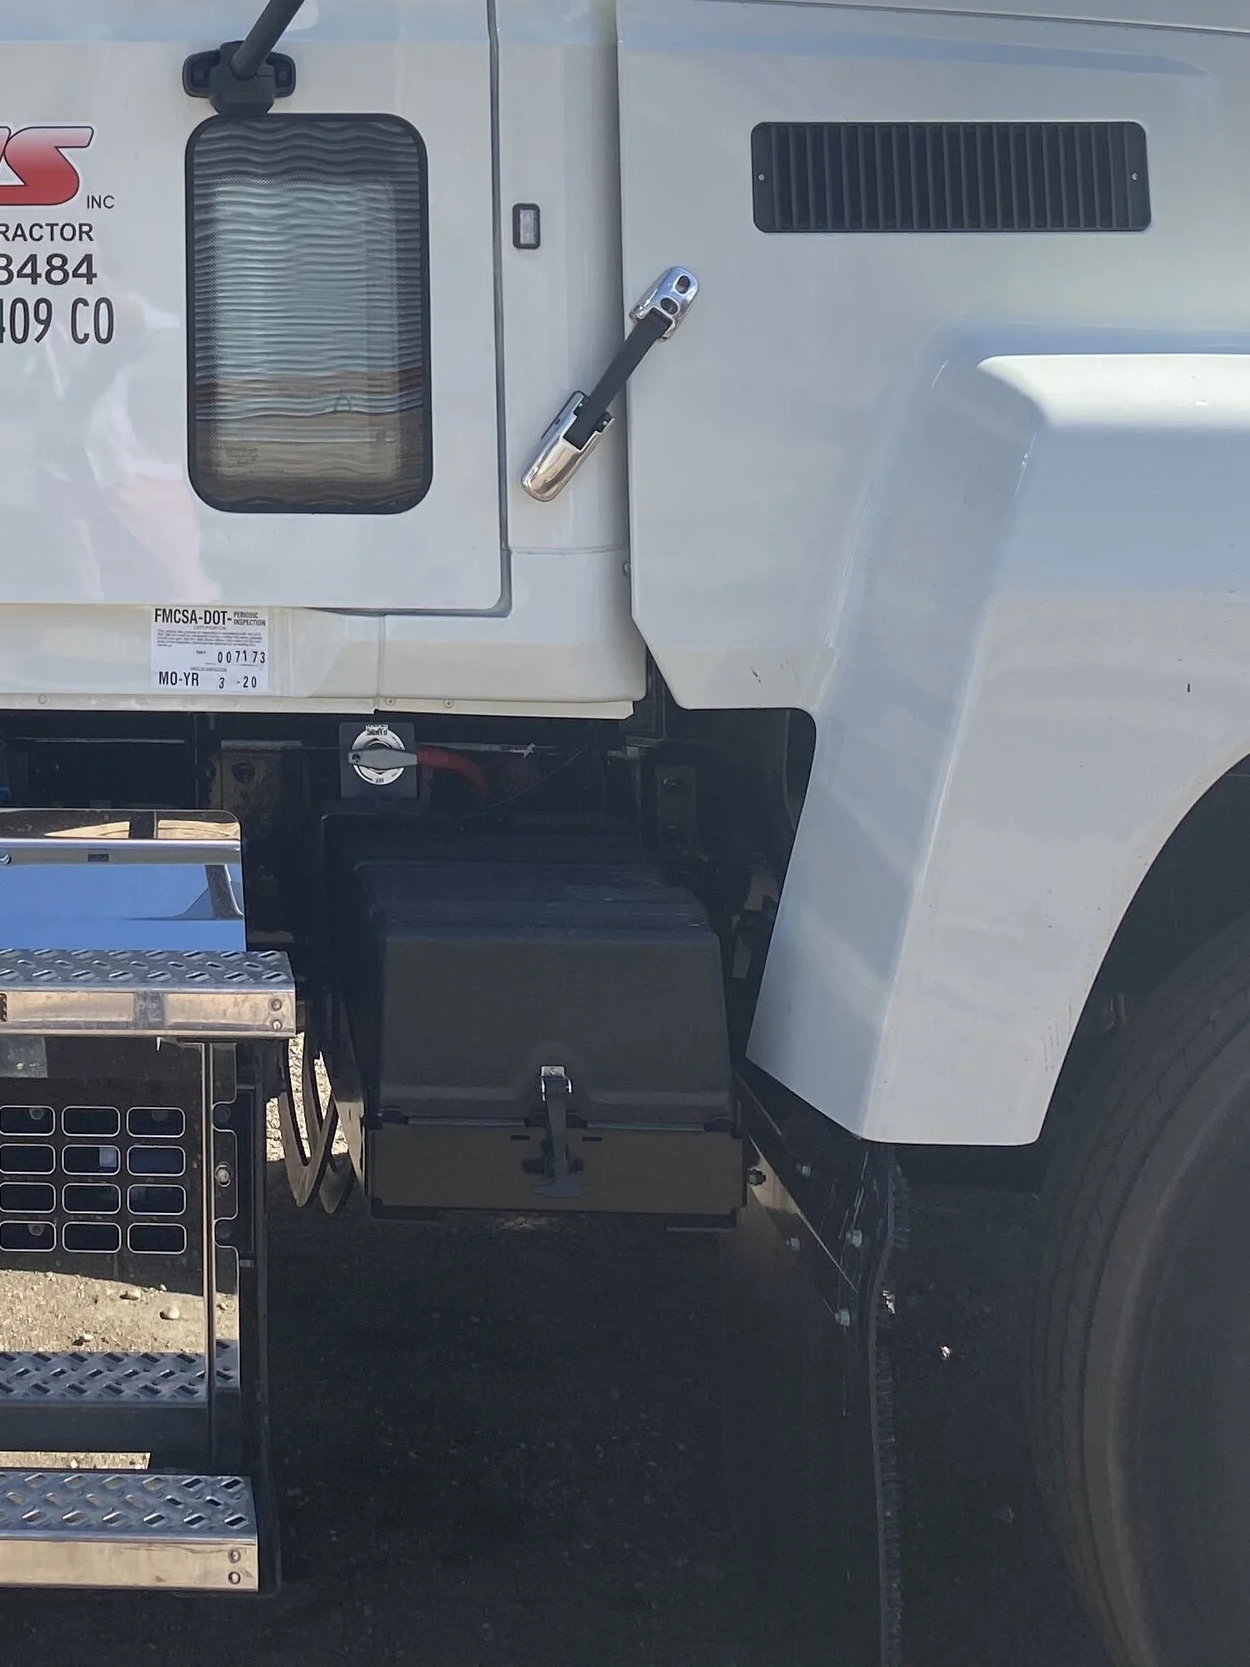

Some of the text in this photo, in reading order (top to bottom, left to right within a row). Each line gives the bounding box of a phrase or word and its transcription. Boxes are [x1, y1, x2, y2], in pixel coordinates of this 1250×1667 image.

[86, 194, 116, 210] INC
[70, 297, 114, 345] CO
[158, 671, 199, 687] MO-YR
[218, 677, 225, 689] 3
